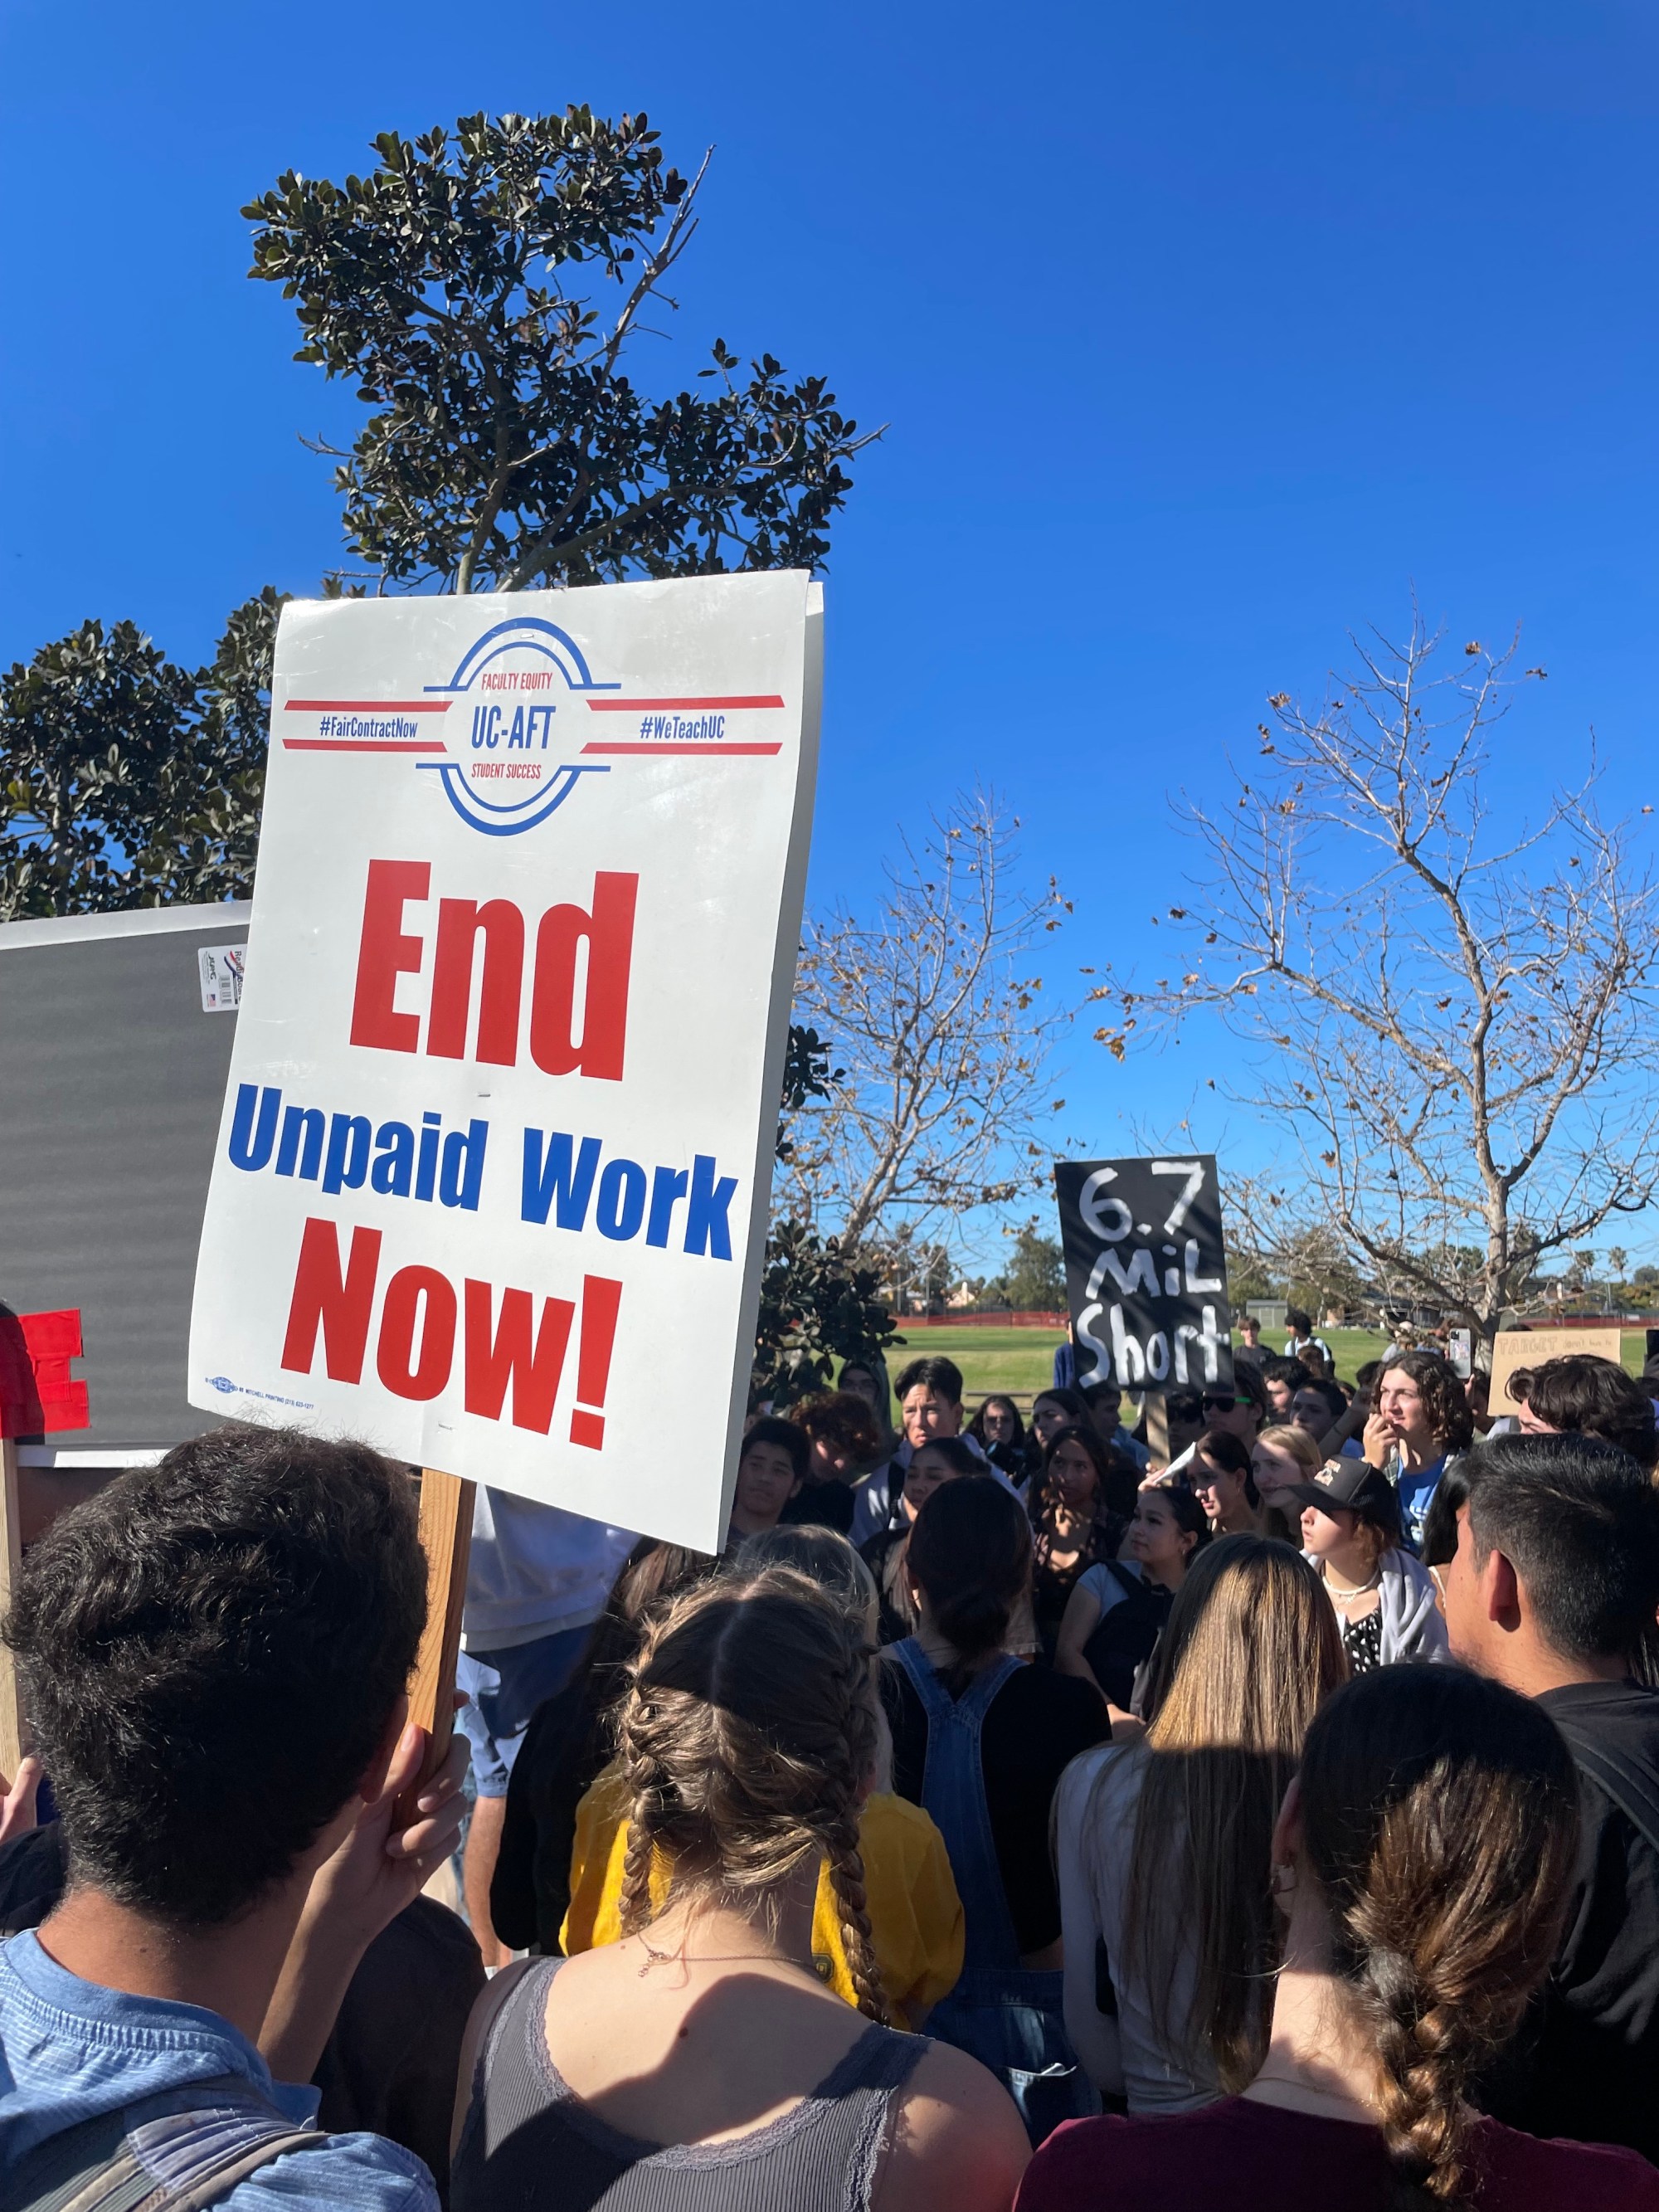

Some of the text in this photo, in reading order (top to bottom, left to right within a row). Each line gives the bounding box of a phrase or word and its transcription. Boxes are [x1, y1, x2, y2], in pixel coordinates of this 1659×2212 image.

[481, 672, 553, 690] FACULTY EQUITY
[319, 715, 418, 739] #FairContractNow
[471, 705, 557, 749] UC-AFT
[640, 715, 725, 739] #WeTeachUC
[471, 763, 542, 780] STUDENT SUCCESS
[349, 859, 640, 1082] End
[228, 1084, 738, 1262] Unpaid Work
[1079, 1161, 1205, 1242] 6.7
[280, 1217, 623, 1451] Now!
[1077, 1303, 1230, 1389] Short
